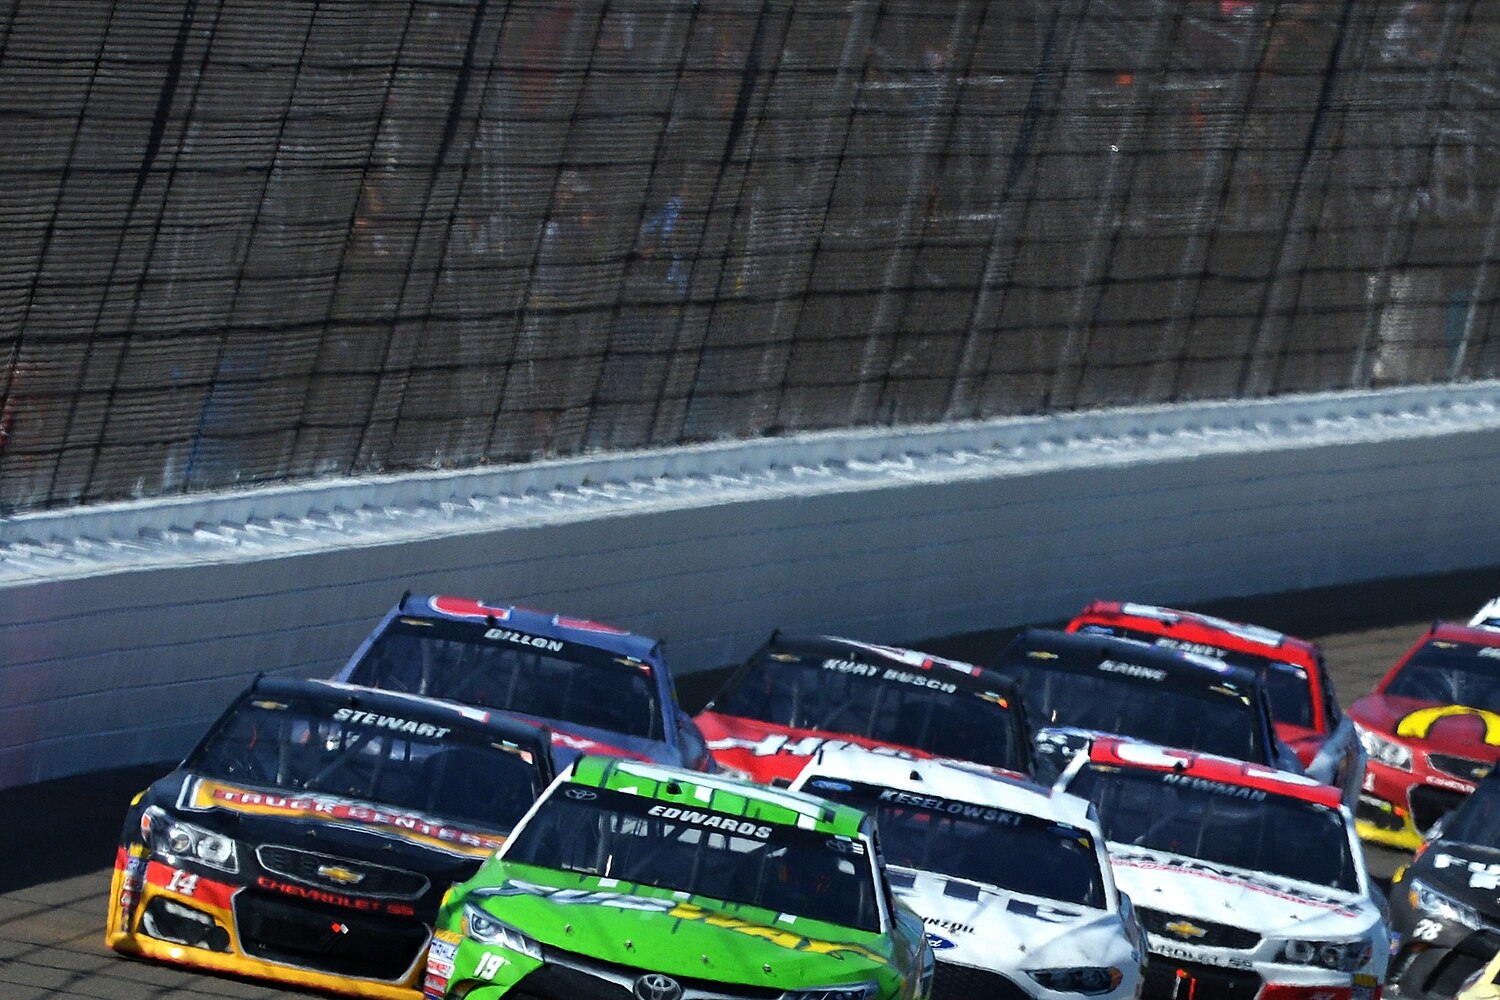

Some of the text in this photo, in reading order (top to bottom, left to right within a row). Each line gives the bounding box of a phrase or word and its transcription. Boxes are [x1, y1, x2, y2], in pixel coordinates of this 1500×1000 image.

[485, 627, 563, 651] DILLON
[823, 658, 957, 693] KURT BUSCH
[333, 708, 450, 739] STEWART
[1163, 773, 1267, 801] NEWMAN
[224, 790, 334, 815] TRUCK
[879, 788, 1023, 827] KESELOWSKI
[648, 803, 773, 838] EDWARDS
[165, 869, 200, 896] 14
[258, 875, 381, 911] CHEVROLET
[919, 915, 977, 935] NZOIL
[473, 950, 512, 980] 19
